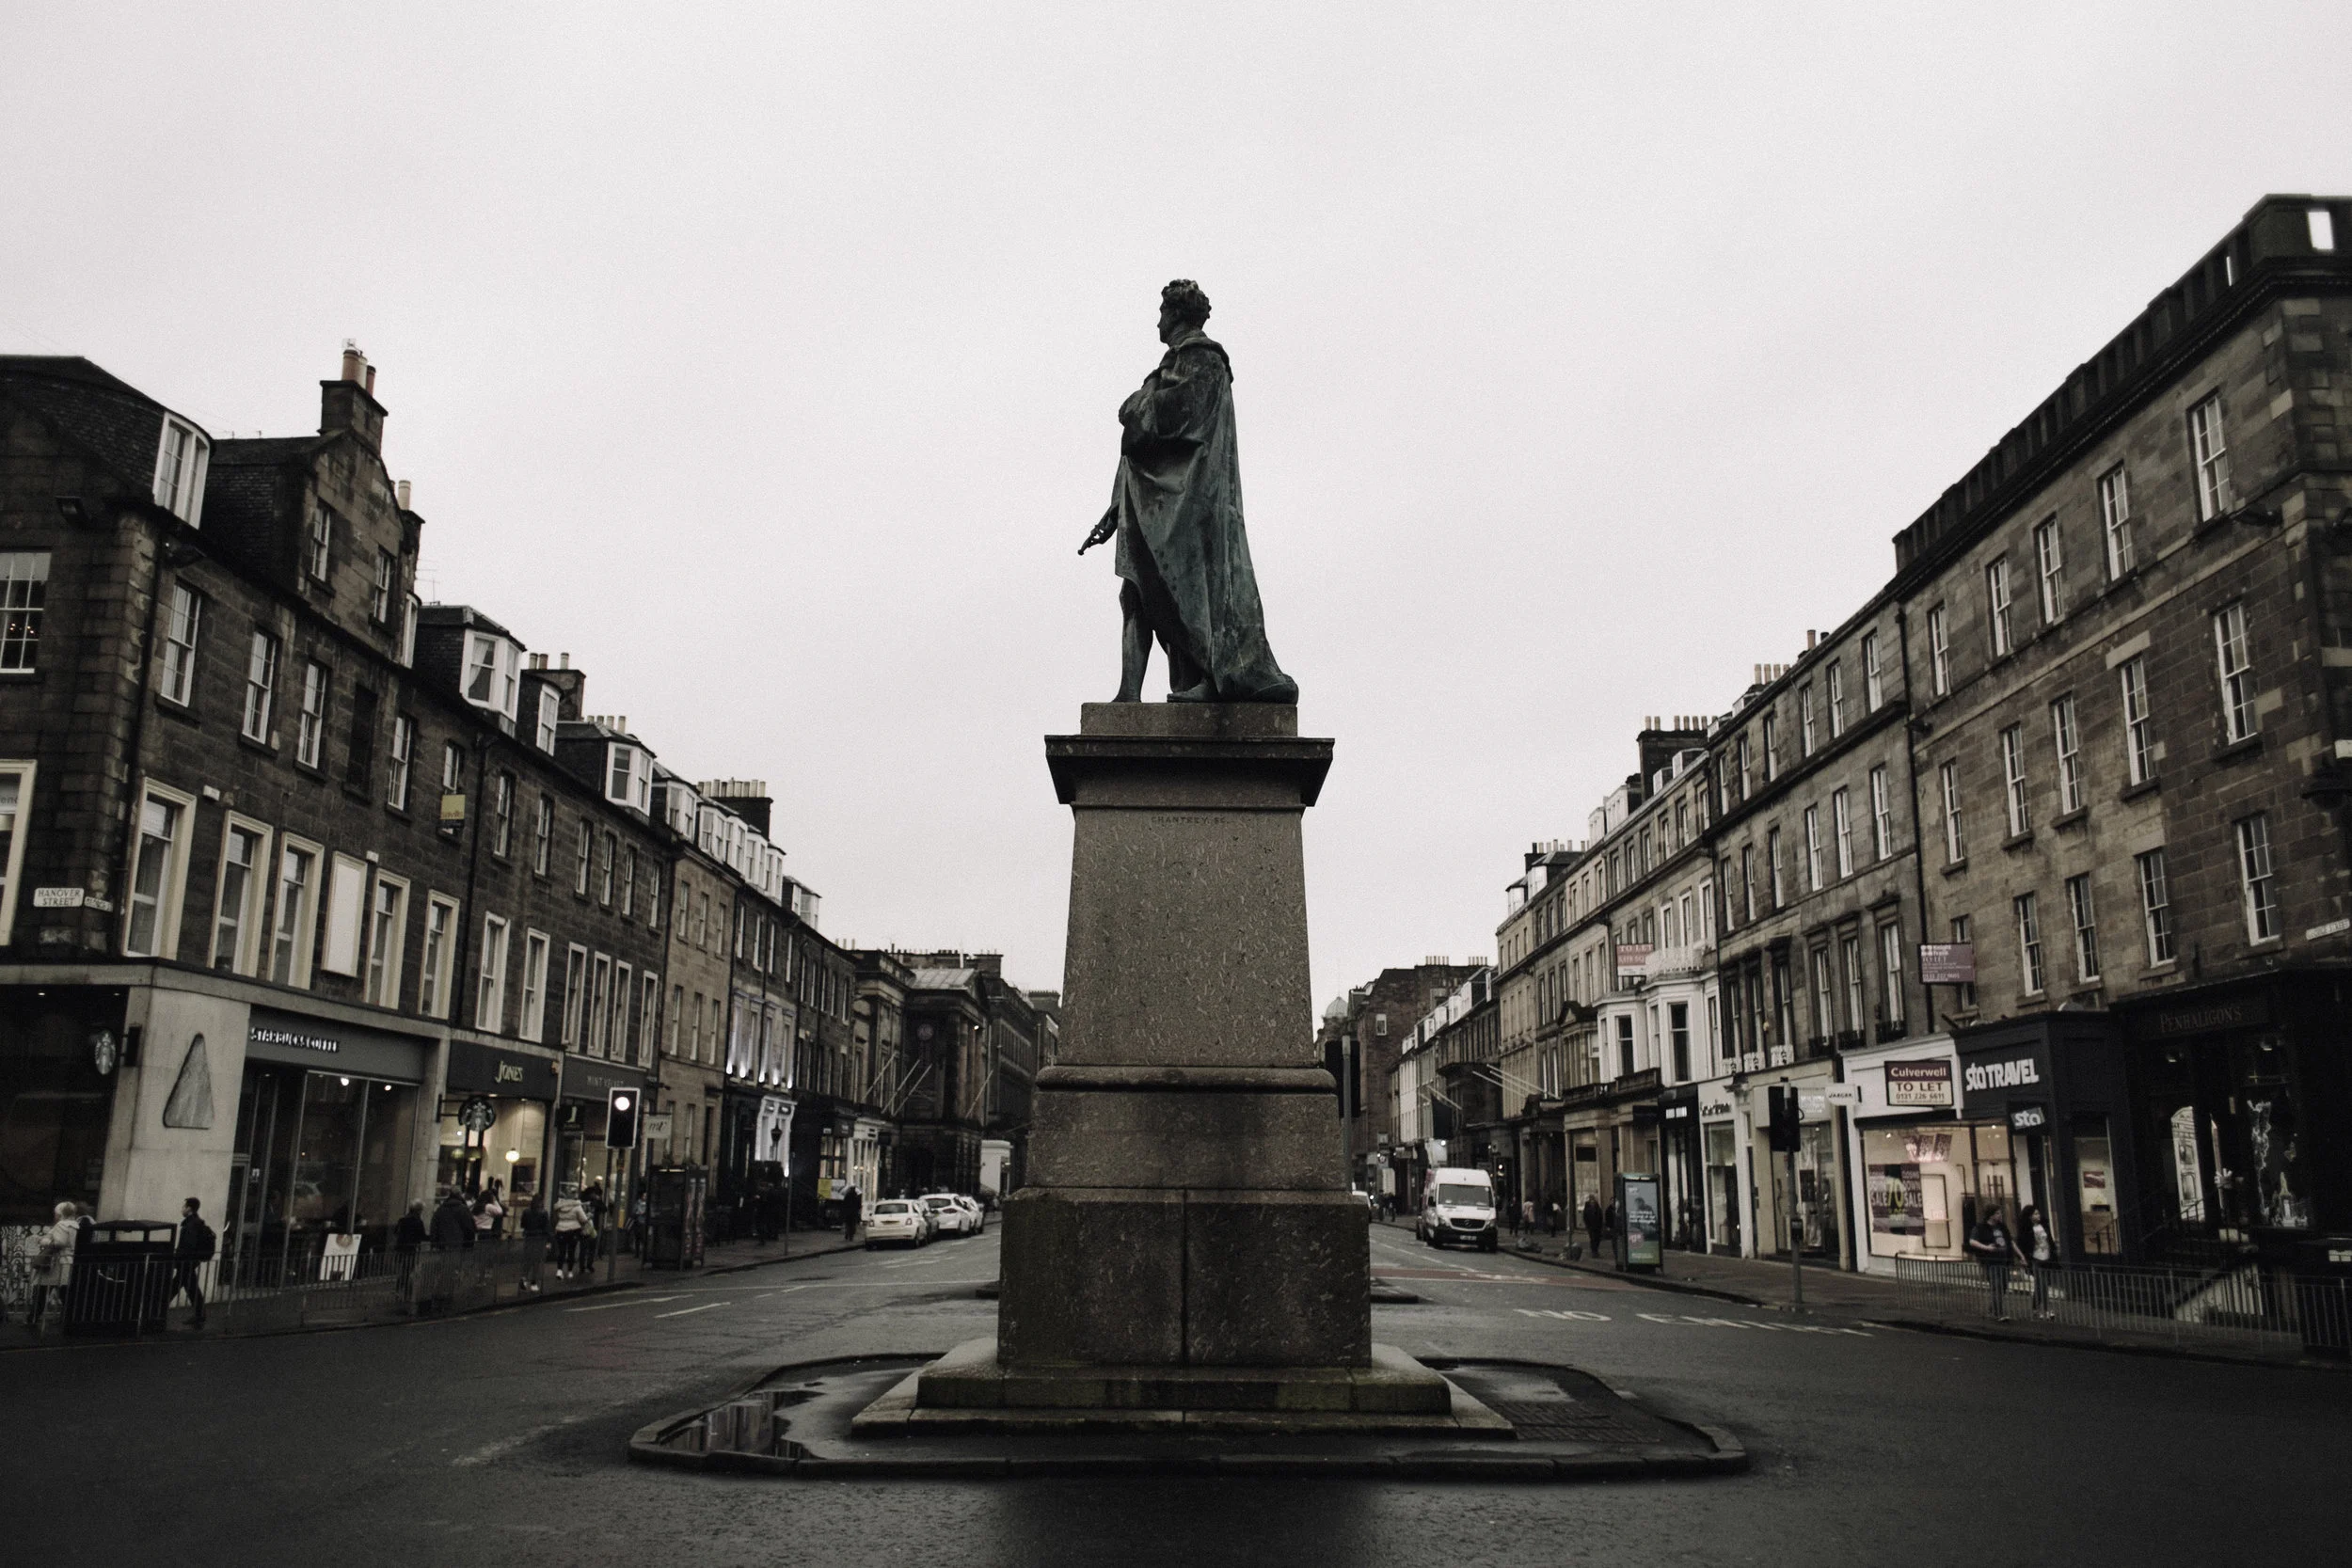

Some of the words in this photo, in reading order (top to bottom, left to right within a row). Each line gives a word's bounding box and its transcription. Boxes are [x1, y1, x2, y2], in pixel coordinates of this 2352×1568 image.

[38, 889, 81, 897] HANOVER
[42, 897, 75, 906] STREET
[495, 1060, 524, 1083] JONES
[1890, 1067, 1947, 1077] Culverwell
[1985, 1058, 2040, 1088] TRAVEL
[1897, 1083, 1914, 1091] TO
[1920, 1082, 1944, 1091] LET
[2014, 1110, 2042, 1127] sta
[1904, 1192, 1923, 1208] SALE
[1513, 1308, 1613, 1322] NO
